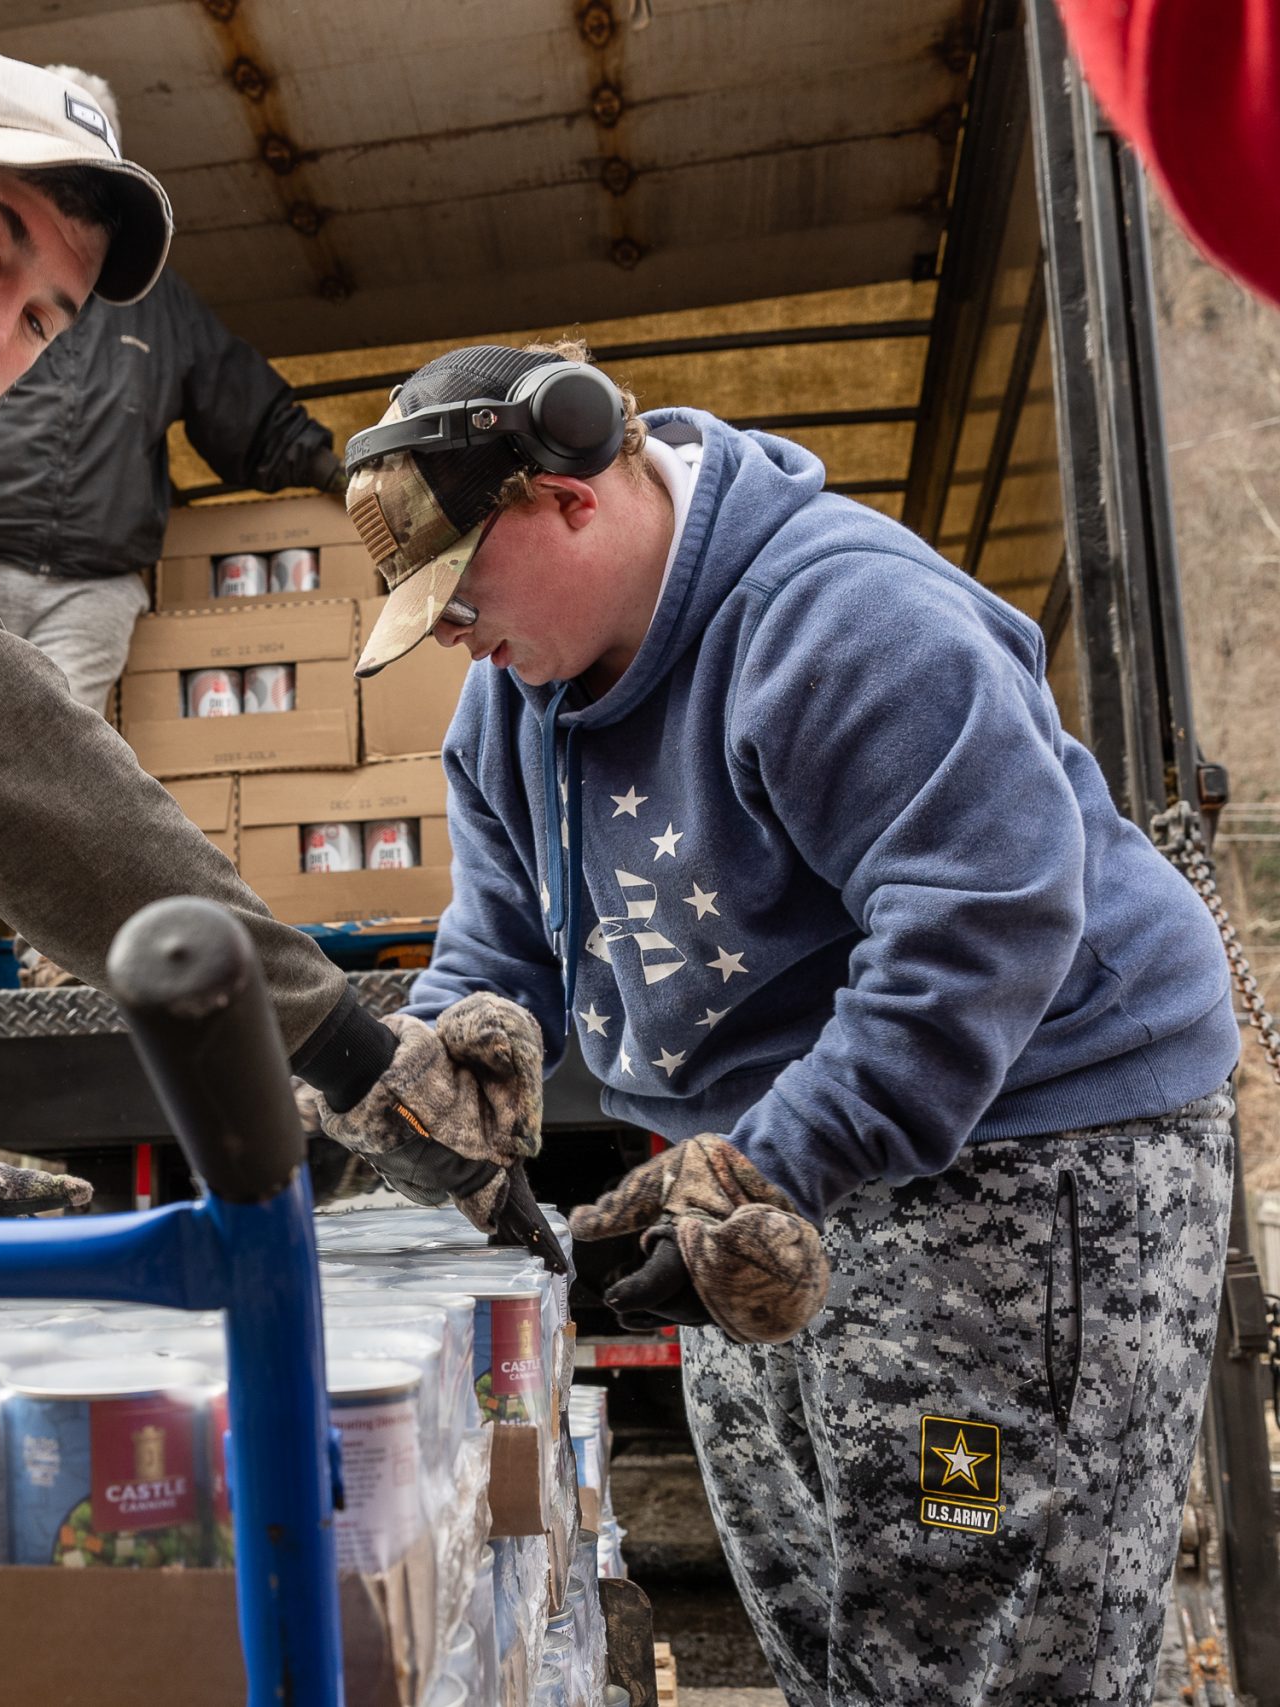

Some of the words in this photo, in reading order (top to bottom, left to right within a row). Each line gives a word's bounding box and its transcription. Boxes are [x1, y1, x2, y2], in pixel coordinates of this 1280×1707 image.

[211, 646, 231, 657] DEC
[257, 643, 285, 653] 2024
[329, 800, 352, 811] DEC
[379, 796, 408, 806] 2024
[309, 851, 329, 864] DIET
[378, 847, 401, 860] DIET
[105, 1478, 187, 1502] CASTLE
